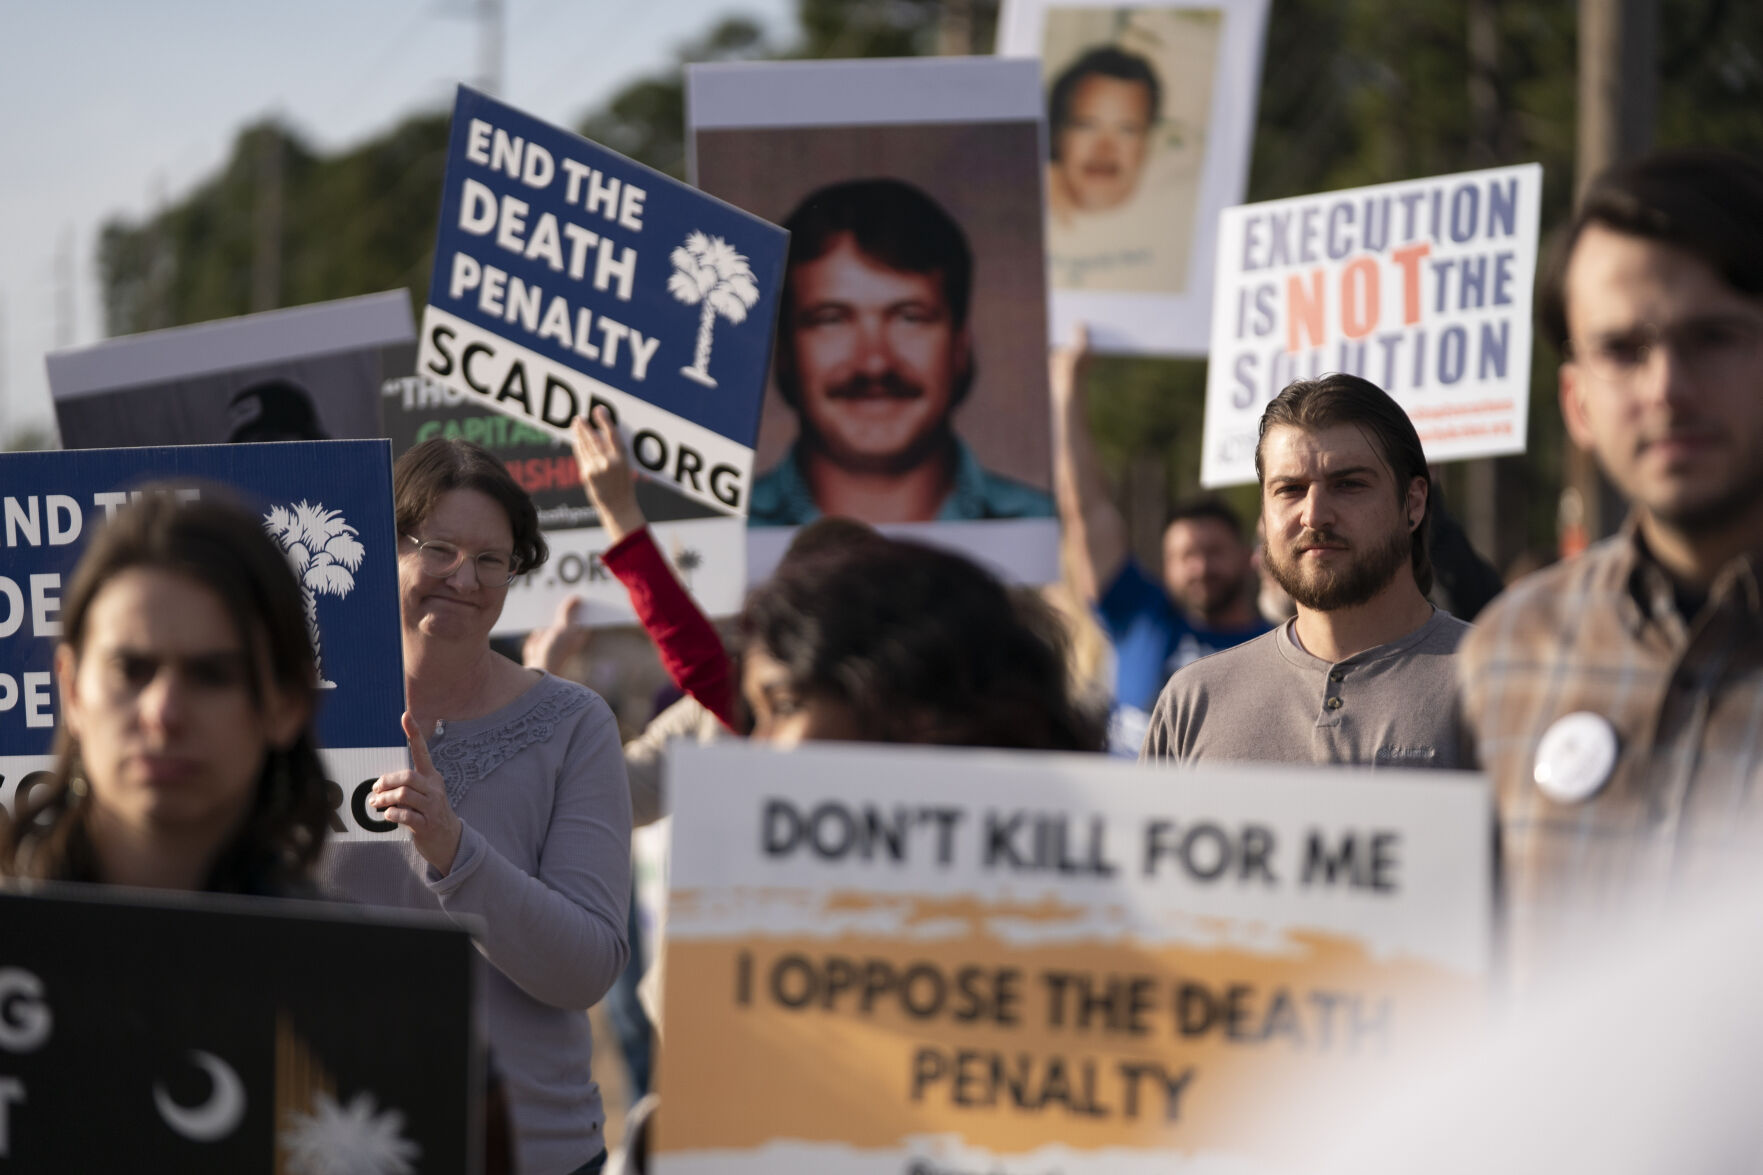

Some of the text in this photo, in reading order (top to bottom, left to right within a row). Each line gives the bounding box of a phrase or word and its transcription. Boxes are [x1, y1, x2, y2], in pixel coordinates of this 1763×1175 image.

[465, 118, 647, 231] END THE
[1241, 177, 1519, 272] EXECUTION
[459, 178, 637, 301] DEATH
[450, 252, 660, 381] PENALTY
[1236, 243, 1515, 356] IS NOT THE
[427, 325, 742, 508] SCADPORG
[2, 494, 83, 547] ND
[760, 797, 1402, 894] DON'T KILL FOR ME
[736, 951, 1394, 1056] I OPPOSE THE DEATH
[910, 1049, 1195, 1127] PENALTY
